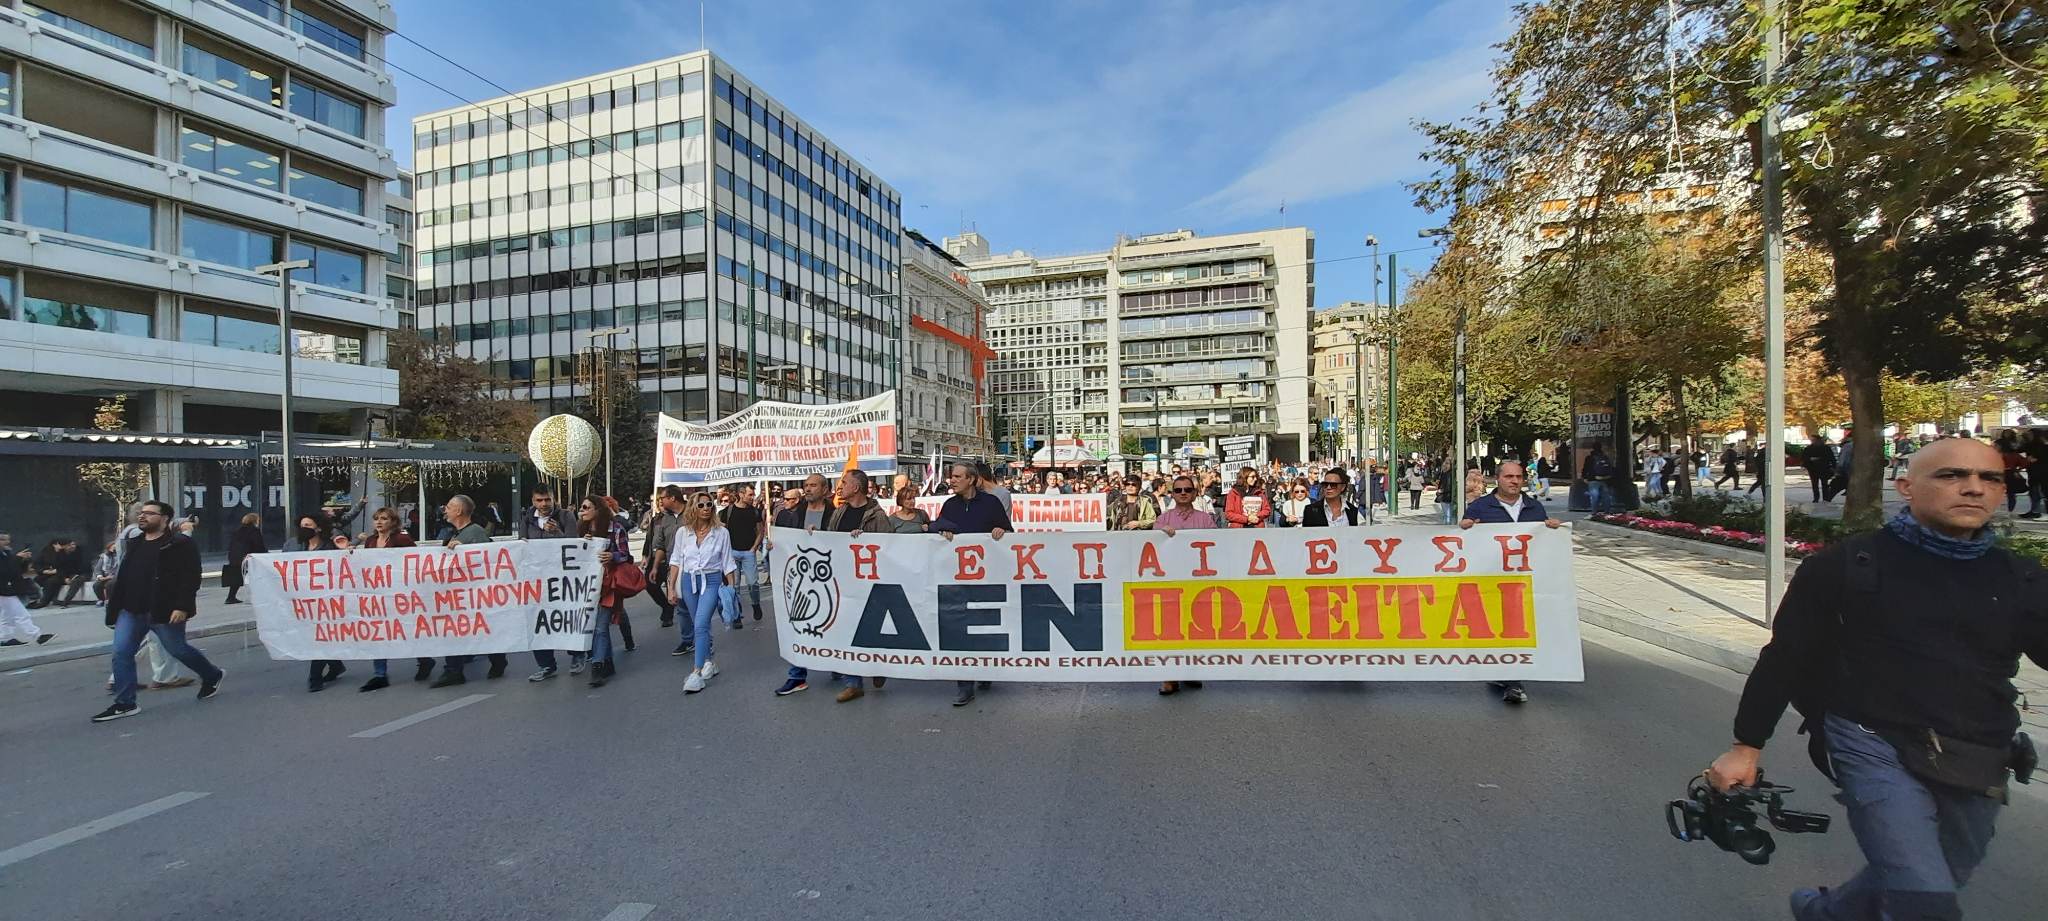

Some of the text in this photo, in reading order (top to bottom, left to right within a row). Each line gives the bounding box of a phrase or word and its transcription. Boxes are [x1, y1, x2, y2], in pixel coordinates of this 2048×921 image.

[665, 429, 681, 440] ΤΗΝ
[743, 418, 777, 431] ΟΛΕΙΩΝ
[778, 420, 799, 430] ΜΑΣ
[800, 419, 816, 430] ΚΑΙ
[818, 419, 834, 430] ΤΗΝ
[834, 409, 889, 426] ΚΑΤΑΣΤΟΛΗ!
[814, 404, 861, 418] ΕΞΑΘΛΙΩΣΗ
[675, 444, 710, 457] ΛΕΦΤΑ
[736, 434, 779, 449] ΠΑΙΔΕΙΑ,
[780, 433, 821, 448] ΣΧΟΛΕΙΑ
[822, 427, 874, 445] ΑΣΦΑΛΗ,
[732, 449, 774, 464] ΜΙΣΘΟΥΣ
[774, 449, 791, 461] ΤΩΝ
[793, 444, 874, 461] ΕΚΠΑΙΔΕΥΤΙΩΝ!
[704, 464, 836, 481] ΣΥΛΛΟΓΟΙ ΚΑΙ ΕΛΜΕ ΑΤΤΙΚΗΣ
[1029, 499, 1103, 523] ΠΑΙΔΕΙΑ
[273, 557, 356, 593] ΥΓΕΙΑ
[403, 548, 518, 587] ΠΑΙΔΕΙΑ
[849, 534, 1534, 580] Η ΕΚΠΑΙΔΕΥΣΗ
[292, 578, 543, 621] ΗΤΑΝ ΚΑΙ ΘΑ ΜΕΙΝΟΥΝ
[547, 575, 597, 603] ΕΛΜΕ
[850, 582, 1104, 652] ΔΕΝ
[1129, 581, 1531, 641] ΠΩΛΕΙΤΑΙ
[315, 611, 491, 642] ΔΗΜΟΣΙΑ ΑΓΑΘΑ
[792, 643, 1535, 668] ΟΜΟΣΠΟΝΔΙΑ ΙΔΙΩΤΙΚΩΝ ΕΚΠΑΙΔΕΥΤΙΚΩΝ ΛΕΙΤΟΥΡΓΩΝ ΕΛΛΑΔΟΣ
